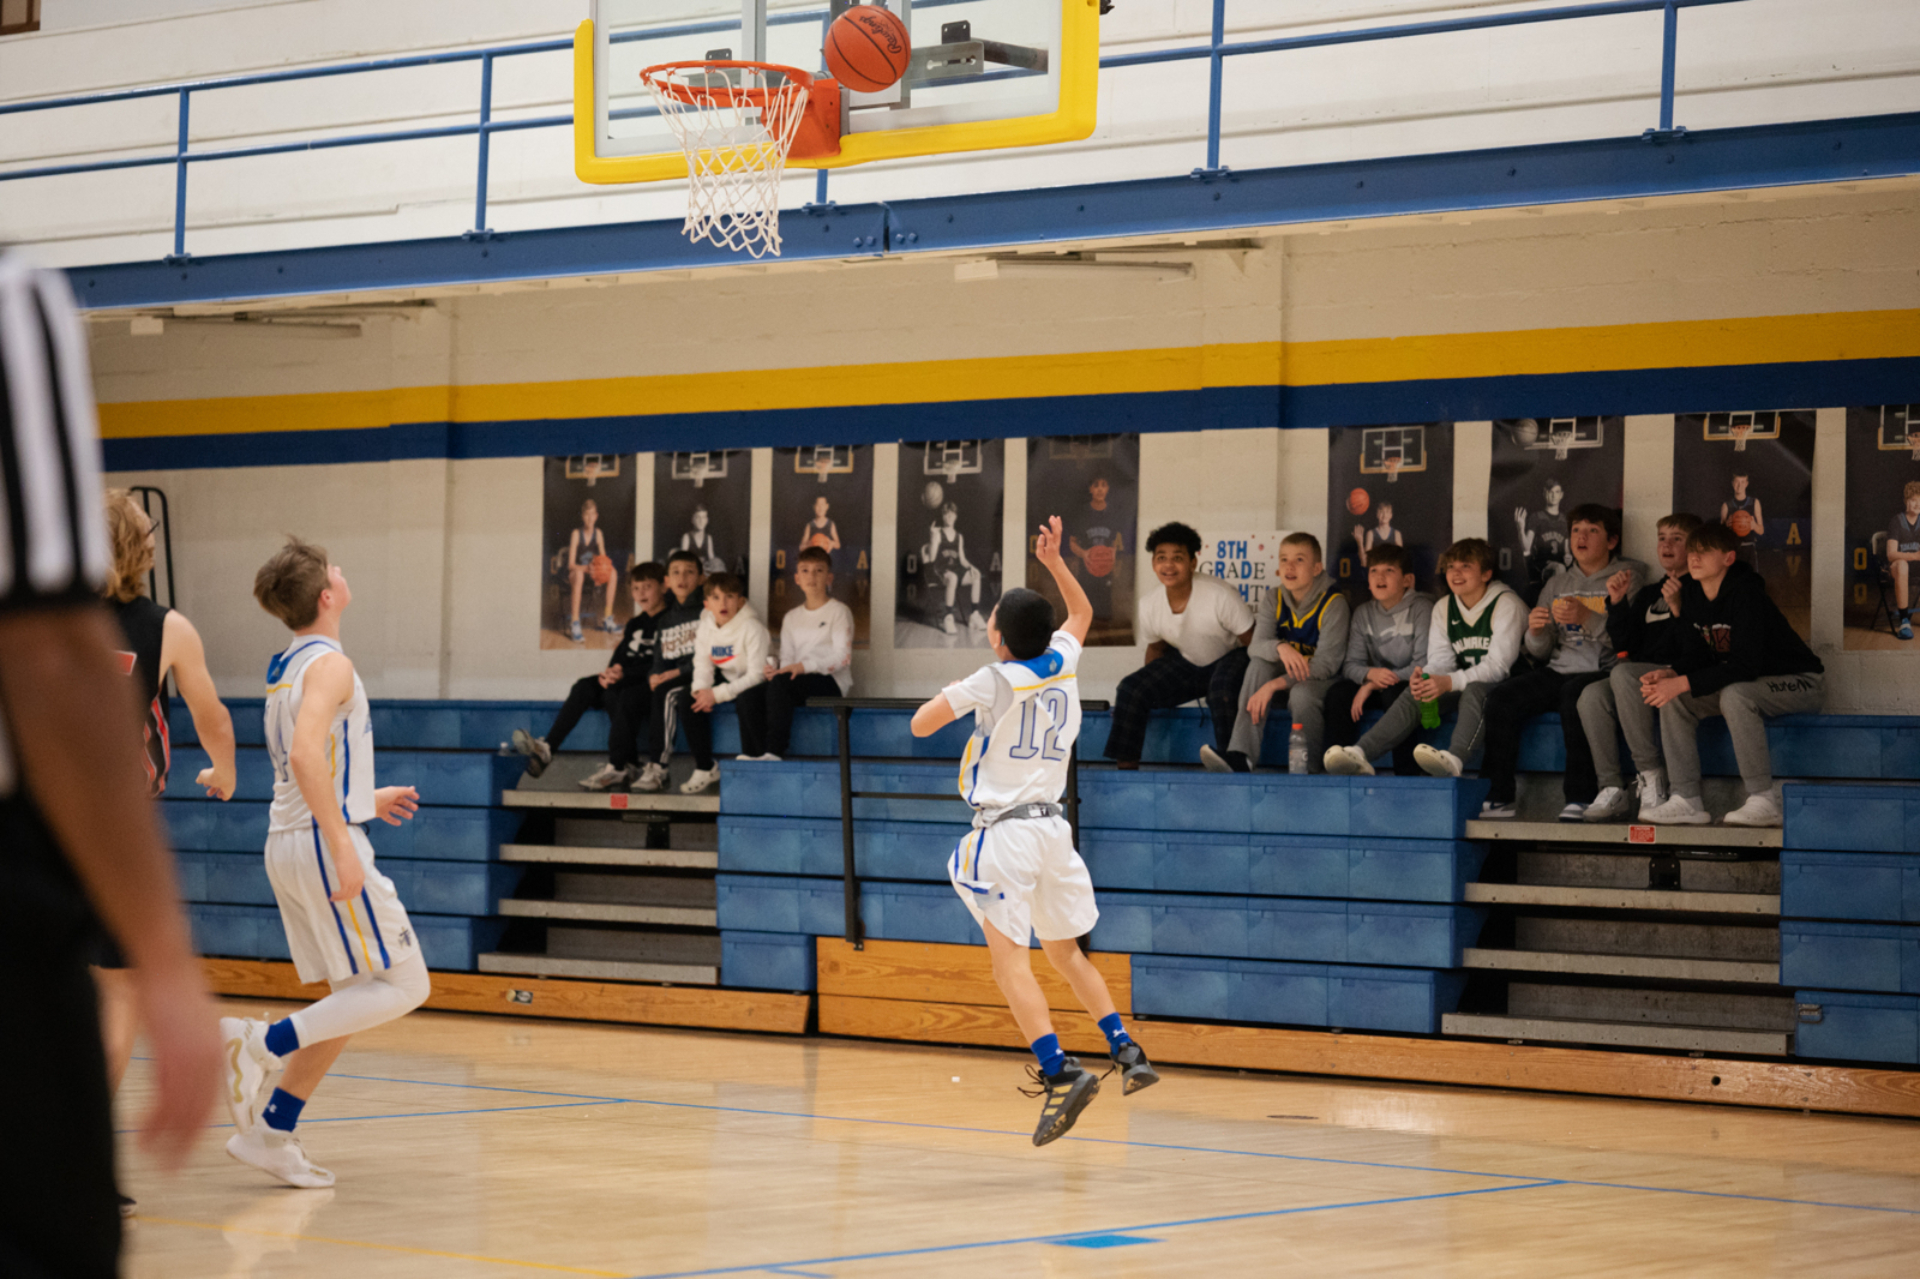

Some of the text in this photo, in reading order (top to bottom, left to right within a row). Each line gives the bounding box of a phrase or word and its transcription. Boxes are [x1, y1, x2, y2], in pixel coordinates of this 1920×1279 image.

[859, 15, 902, 54] Rawlings
[1786, 522, 1802, 545] A
[1217, 540, 1248, 559] 8TH
[1199, 560, 1266, 580] GRADE
[711, 645, 734, 657] NIKE
[1009, 686, 1069, 762] 12
